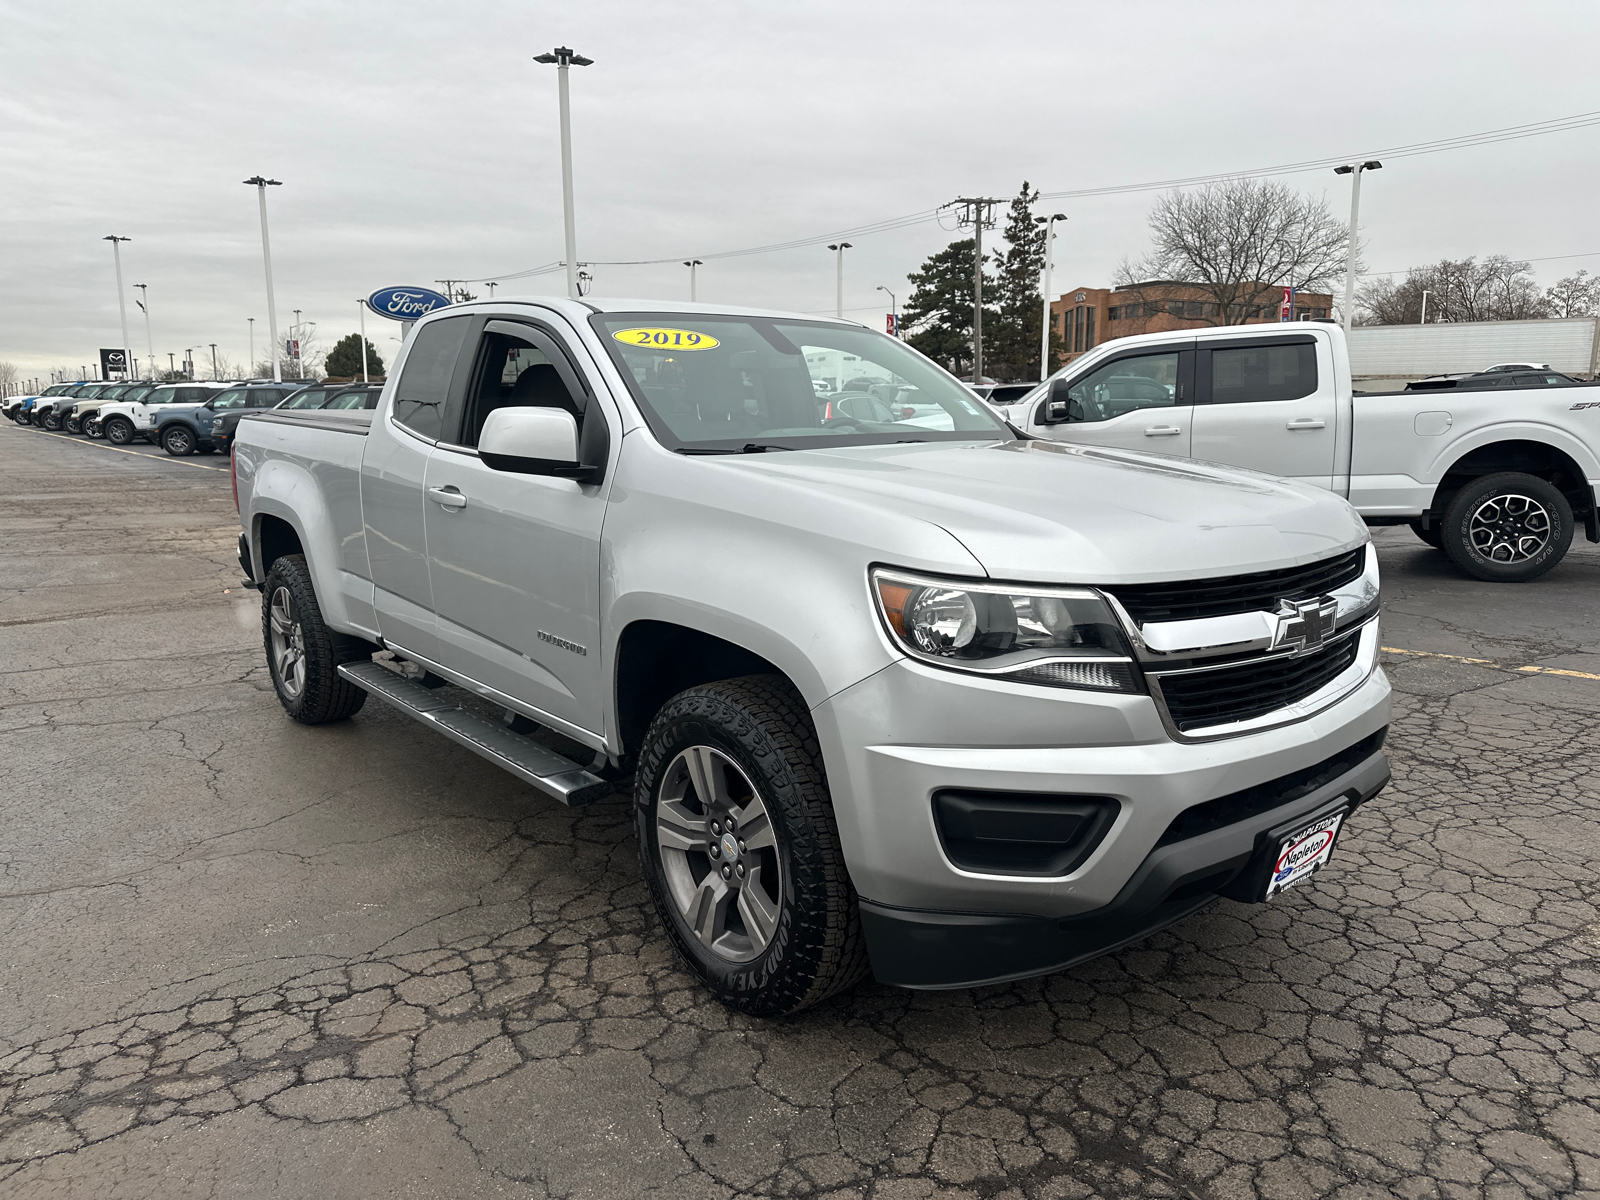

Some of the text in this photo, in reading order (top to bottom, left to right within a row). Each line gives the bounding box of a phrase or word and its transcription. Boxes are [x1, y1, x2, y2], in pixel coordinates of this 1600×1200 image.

[387, 291, 436, 314] Ford
[636, 331, 702, 346] 2019
[1568, 402, 1600, 411] SP
[1460, 489, 1498, 534] COUNTRY
[1546, 502, 1562, 541] TOYO
[1283, 838, 1324, 868] Napleton
